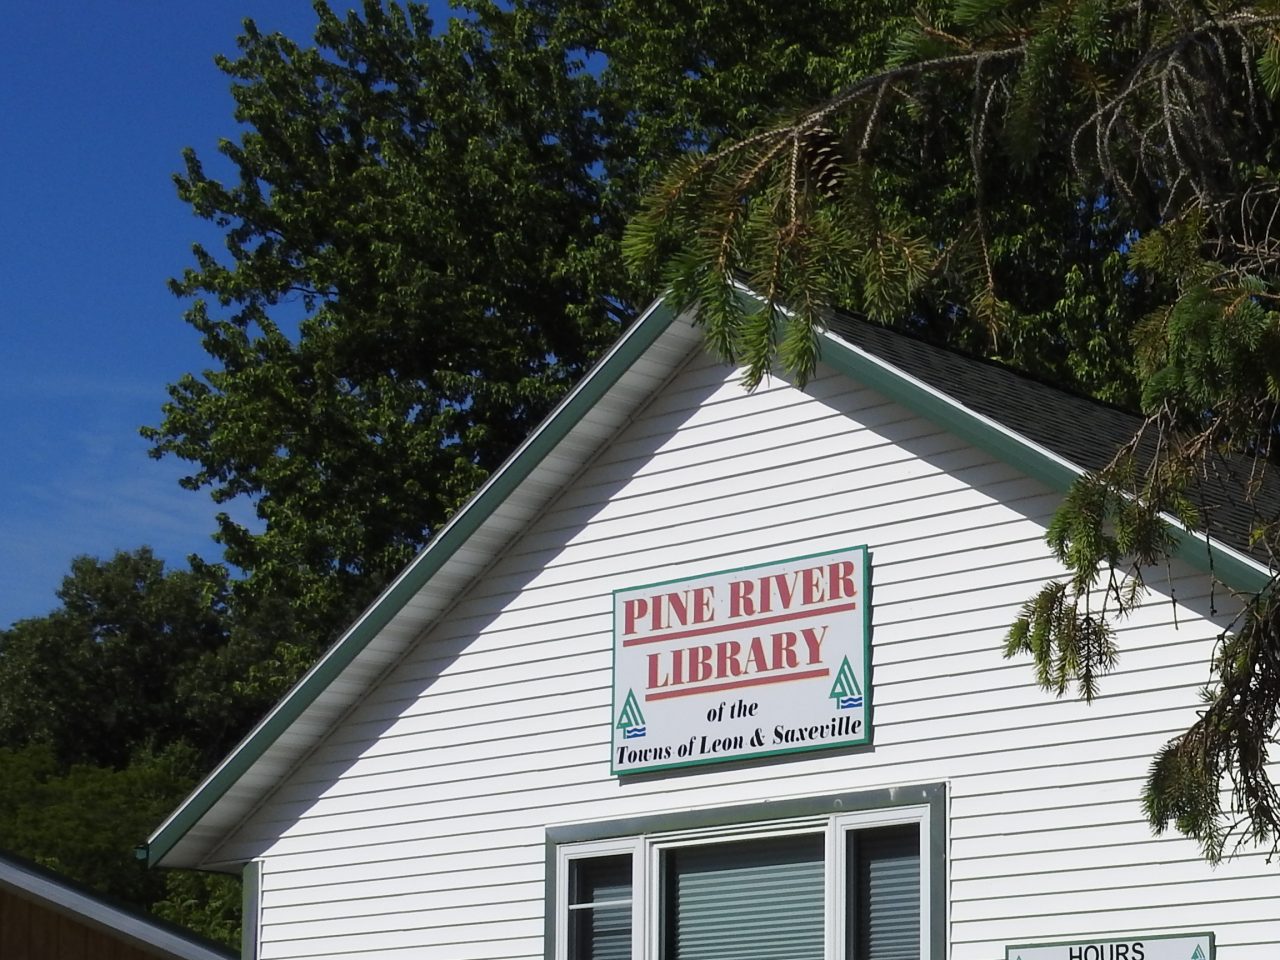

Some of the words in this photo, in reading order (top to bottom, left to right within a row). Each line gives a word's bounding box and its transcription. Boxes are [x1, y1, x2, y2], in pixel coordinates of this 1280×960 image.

[623, 586, 715, 635] PINE
[728, 560, 857, 618] RIVER
[646, 626, 829, 689] LIBRARY
[707, 702, 725, 722] of
[730, 699, 758, 719] the
[617, 745, 671, 764] Towns
[677, 736, 696, 757] of
[699, 735, 743, 755] Leon
[750, 728, 765, 747] &
[772, 716, 862, 745] Saxeville
